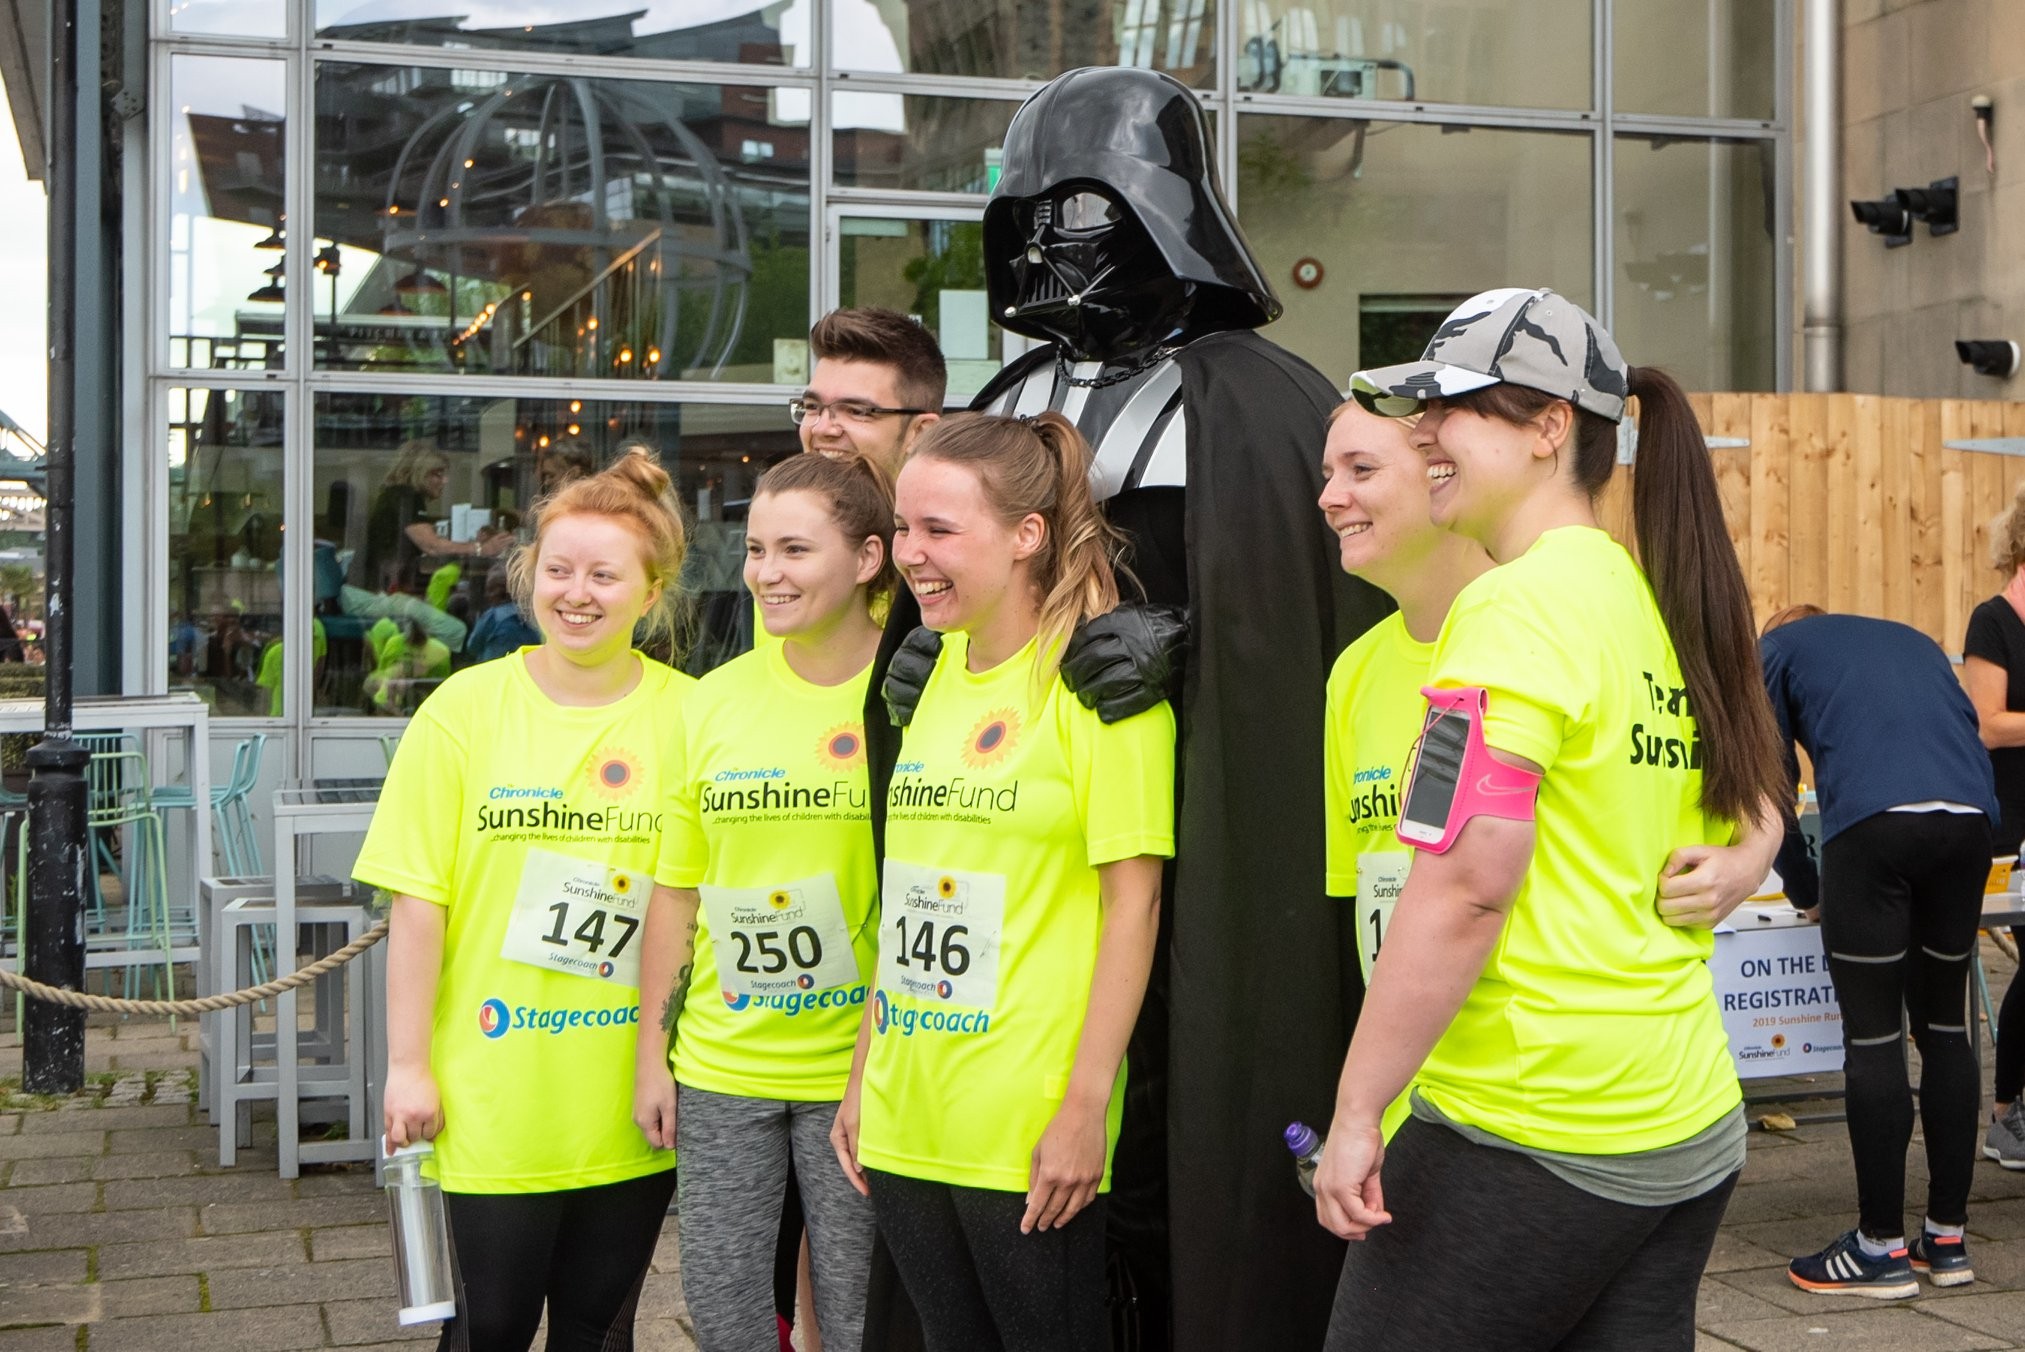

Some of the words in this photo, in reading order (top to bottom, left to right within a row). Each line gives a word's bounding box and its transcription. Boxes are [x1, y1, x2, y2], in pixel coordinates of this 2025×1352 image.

[715, 767, 786, 782] Chronicle
[489, 786, 564, 800] Chronicle
[702, 781, 865, 813] SunshineFu
[890, 777, 1018, 812] shineFund
[750, 814, 763, 822] the
[764, 813, 781, 822] lives
[782, 812, 791, 821] of
[792, 812, 824, 821] children
[825, 812, 842, 821] with
[953, 813, 992, 824] disabilities
[542, 834, 558, 842] lives
[562, 881, 635, 909] SunshineFund
[730, 908, 804, 925] SunshineFund
[541, 901, 640, 958] 147
[730, 925, 823, 974] 250
[896, 916, 970, 976] 146
[548, 952, 598, 969] Stagecoach
[1741, 959, 1771, 978] ON
[1777, 955, 1815, 975] THE
[750, 980, 797, 991] Stagecoach
[1724, 986, 1839, 1011] REGISTRATI
[513, 1004, 639, 1035] Stagecoac
[1753, 1017, 1776, 1027] 2019
[1778, 1013, 1822, 1025] Sunshine
[1739, 1047, 1791, 1060] SunshineFund
